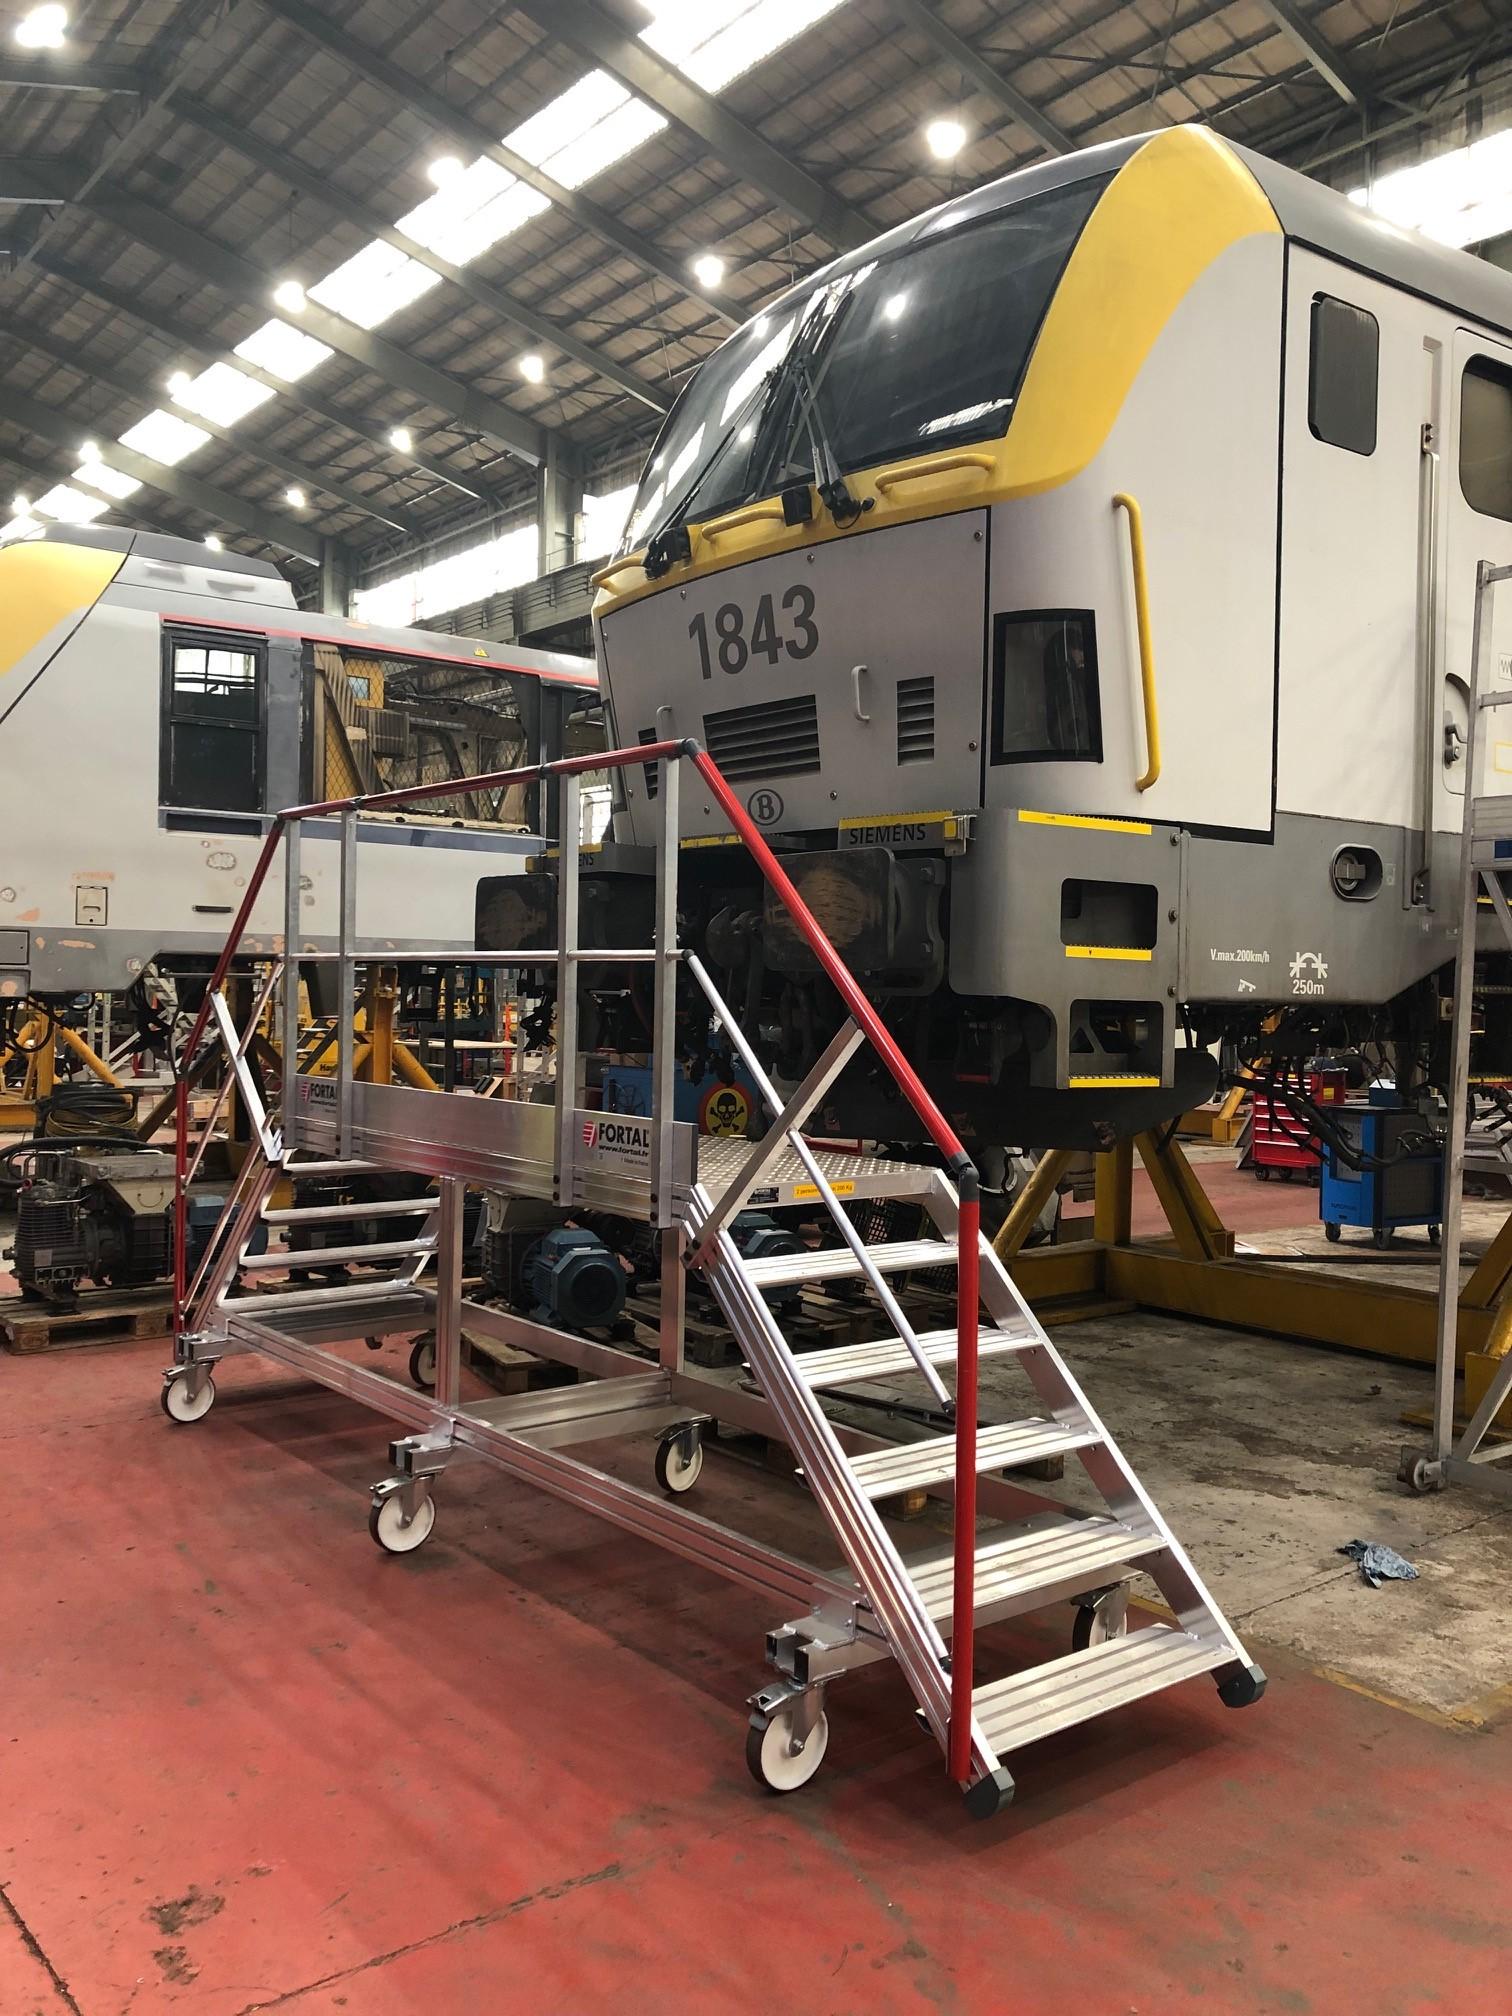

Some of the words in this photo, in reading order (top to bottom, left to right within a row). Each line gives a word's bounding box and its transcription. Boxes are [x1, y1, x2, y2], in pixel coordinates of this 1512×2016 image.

[689, 584, 819, 680] 1843
[848, 822, 927, 845] SIEMENS
[1209, 948, 1270, 963] V.max.200km/h
[1292, 979, 1325, 995] 250m
[310, 1083, 337, 1100] FORTA
[598, 1122, 650, 1148] FORTAL
[598, 1144, 649, 1158] www.fortal.fr
